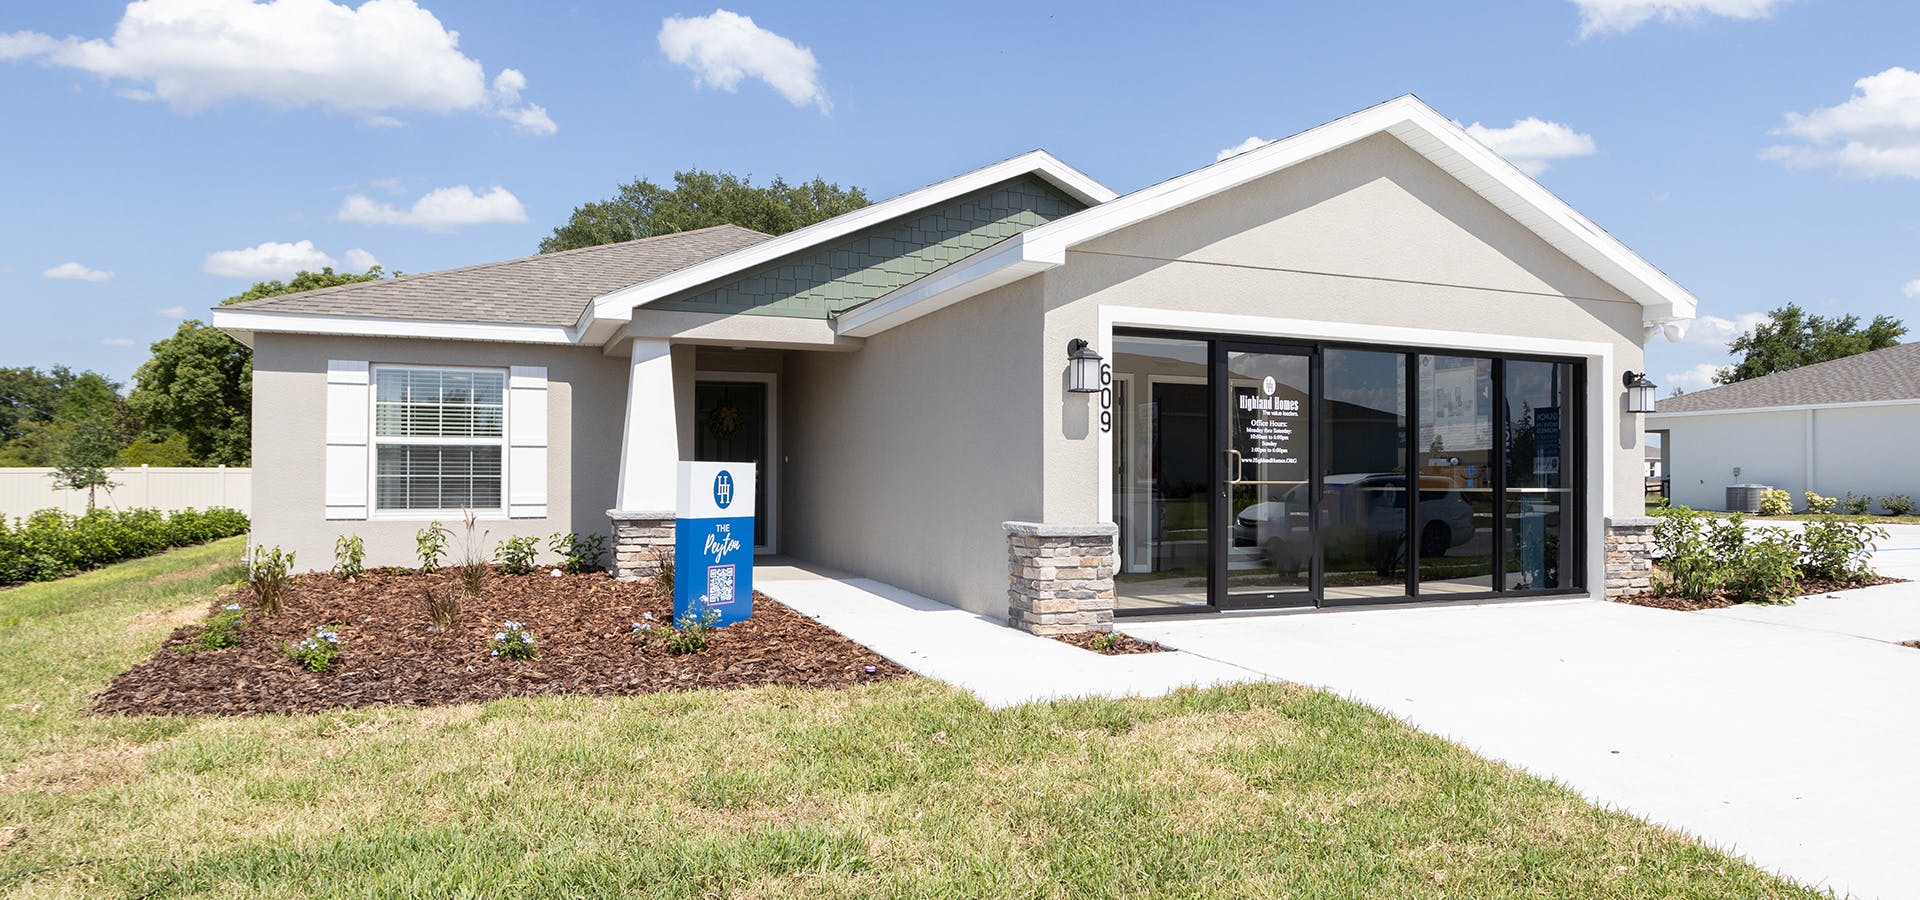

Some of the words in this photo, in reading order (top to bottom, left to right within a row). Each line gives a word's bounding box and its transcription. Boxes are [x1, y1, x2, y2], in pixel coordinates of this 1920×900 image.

[1100, 363, 1111, 433] 609
[1239, 395, 1273, 412] Highland
[1274, 396, 1299, 411] Homes
[1250, 419, 1269, 427] Office
[715, 524, 730, 533] THE
[704, 532, 741, 564] Peyton
